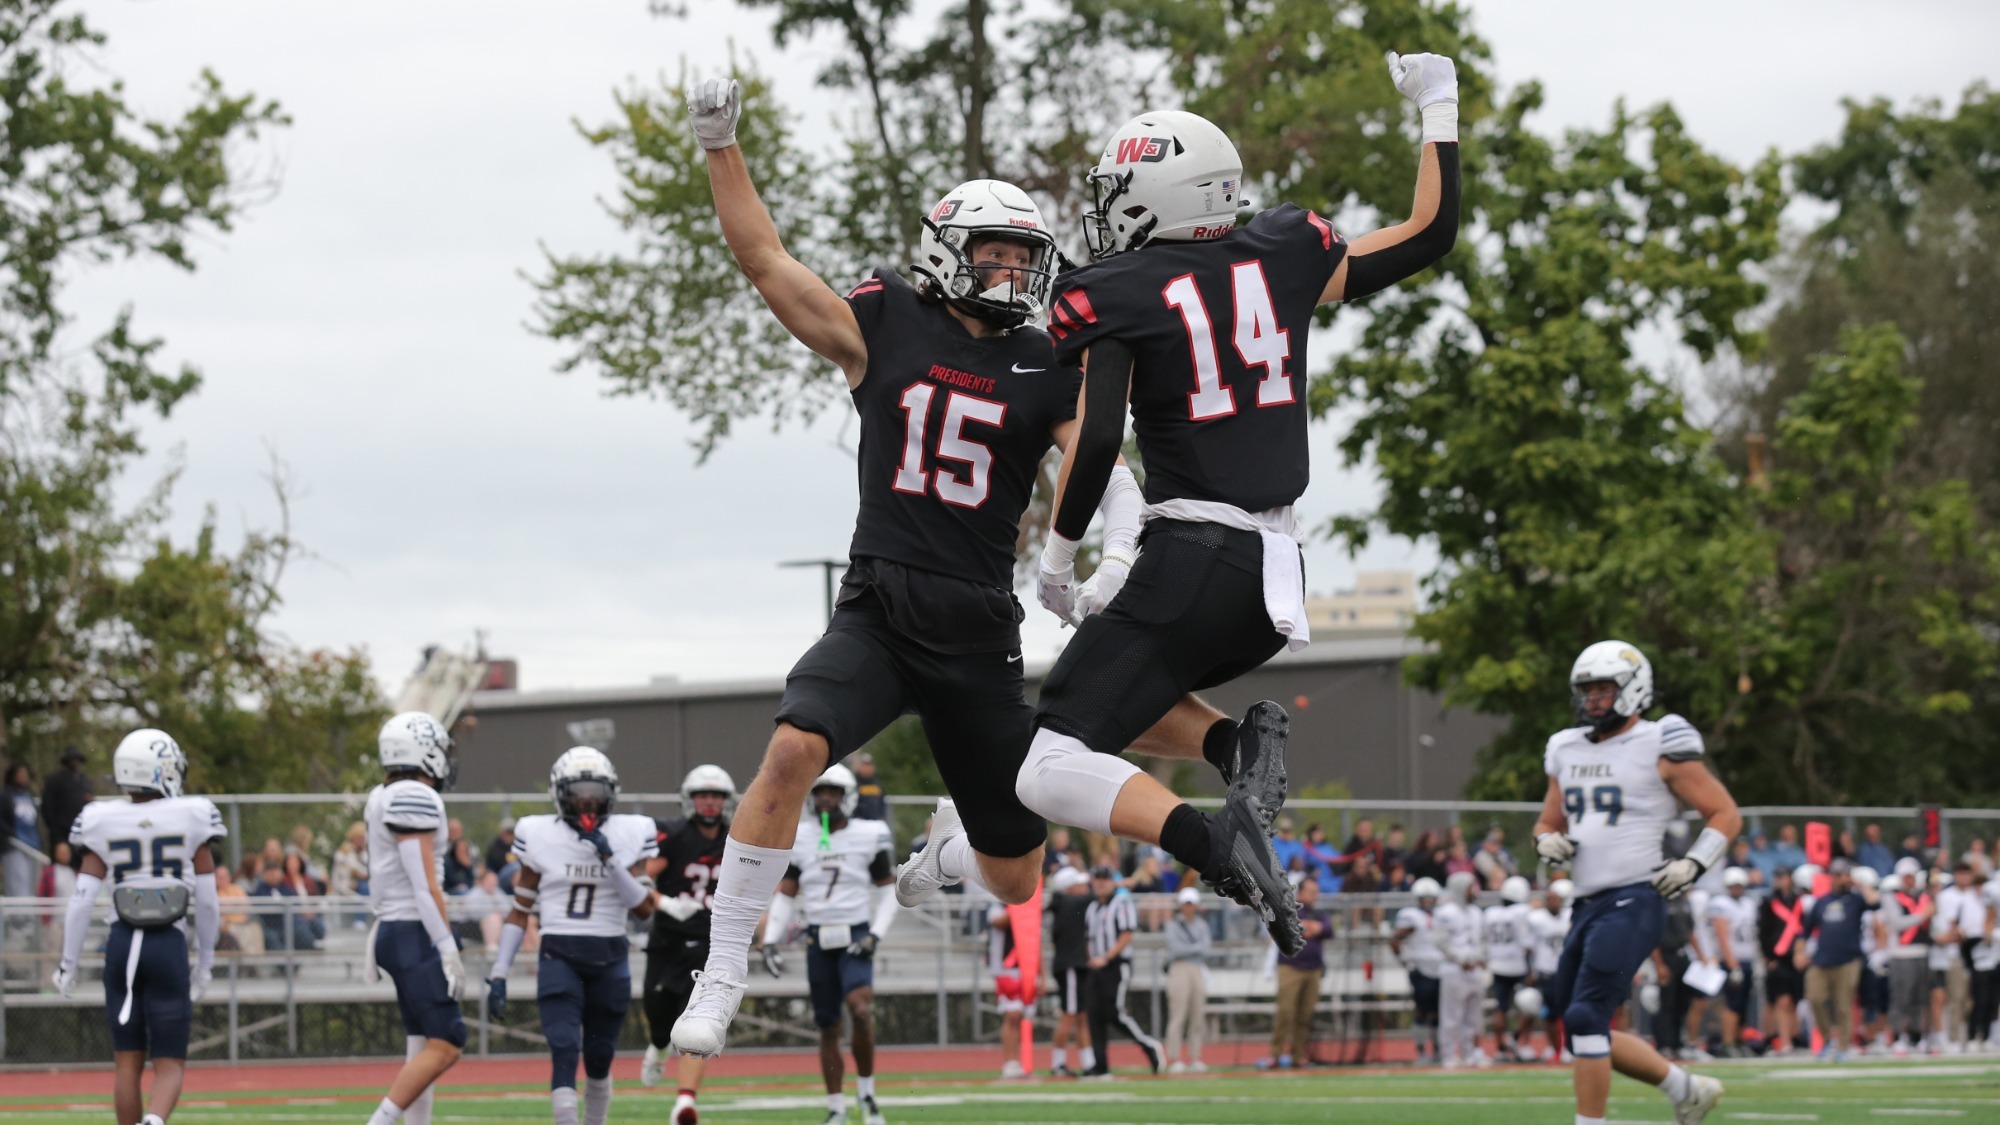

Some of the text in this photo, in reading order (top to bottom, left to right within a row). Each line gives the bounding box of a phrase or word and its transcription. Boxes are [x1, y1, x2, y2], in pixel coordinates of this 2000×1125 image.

[1116, 137, 1171, 164] W&J
[1008, 218, 1038, 229] Riddell
[1193, 224, 1233, 239] Ridd
[1162, 259, 1296, 421] 14
[928, 364, 996, 393] PRESIDENTS
[891, 381, 1008, 510] 15
[1570, 765, 1614, 778] THIEL
[1563, 785, 1623, 826] 99
[107, 836, 186, 884] 26
[565, 863, 609, 878] THIEL
[820, 865, 841, 899] 7
